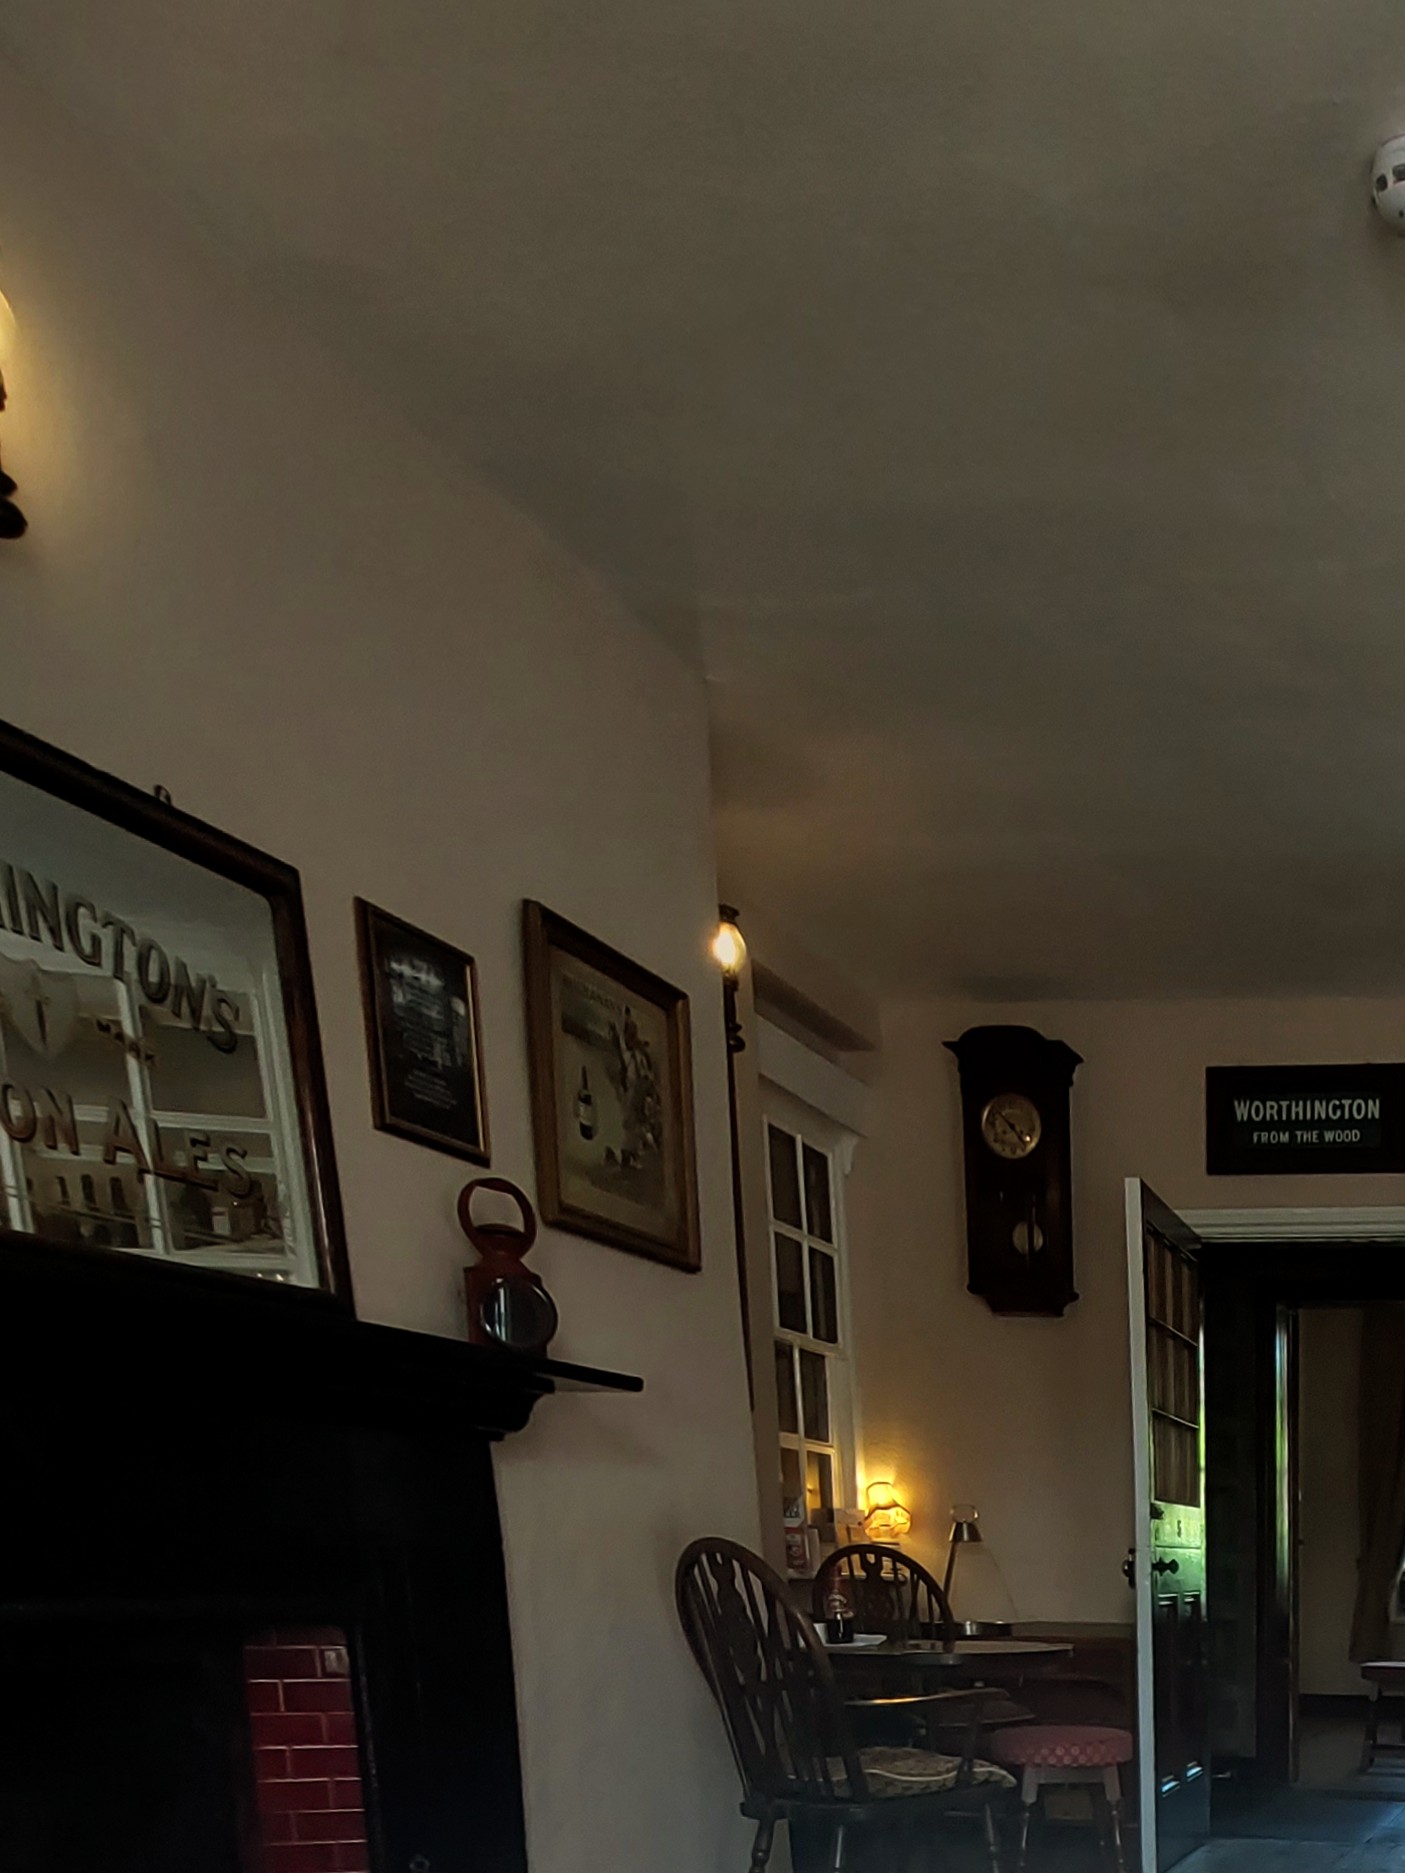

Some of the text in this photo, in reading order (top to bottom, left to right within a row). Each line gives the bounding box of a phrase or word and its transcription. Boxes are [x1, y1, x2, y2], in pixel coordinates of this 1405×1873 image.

[0, 858, 239, 1053] INGTON'S
[1233, 1098, 1381, 1122] WORTHINGTON
[1253, 1129, 1361, 1144] FROM THE WOOD
[103, 1099, 251, 1200] ALES
